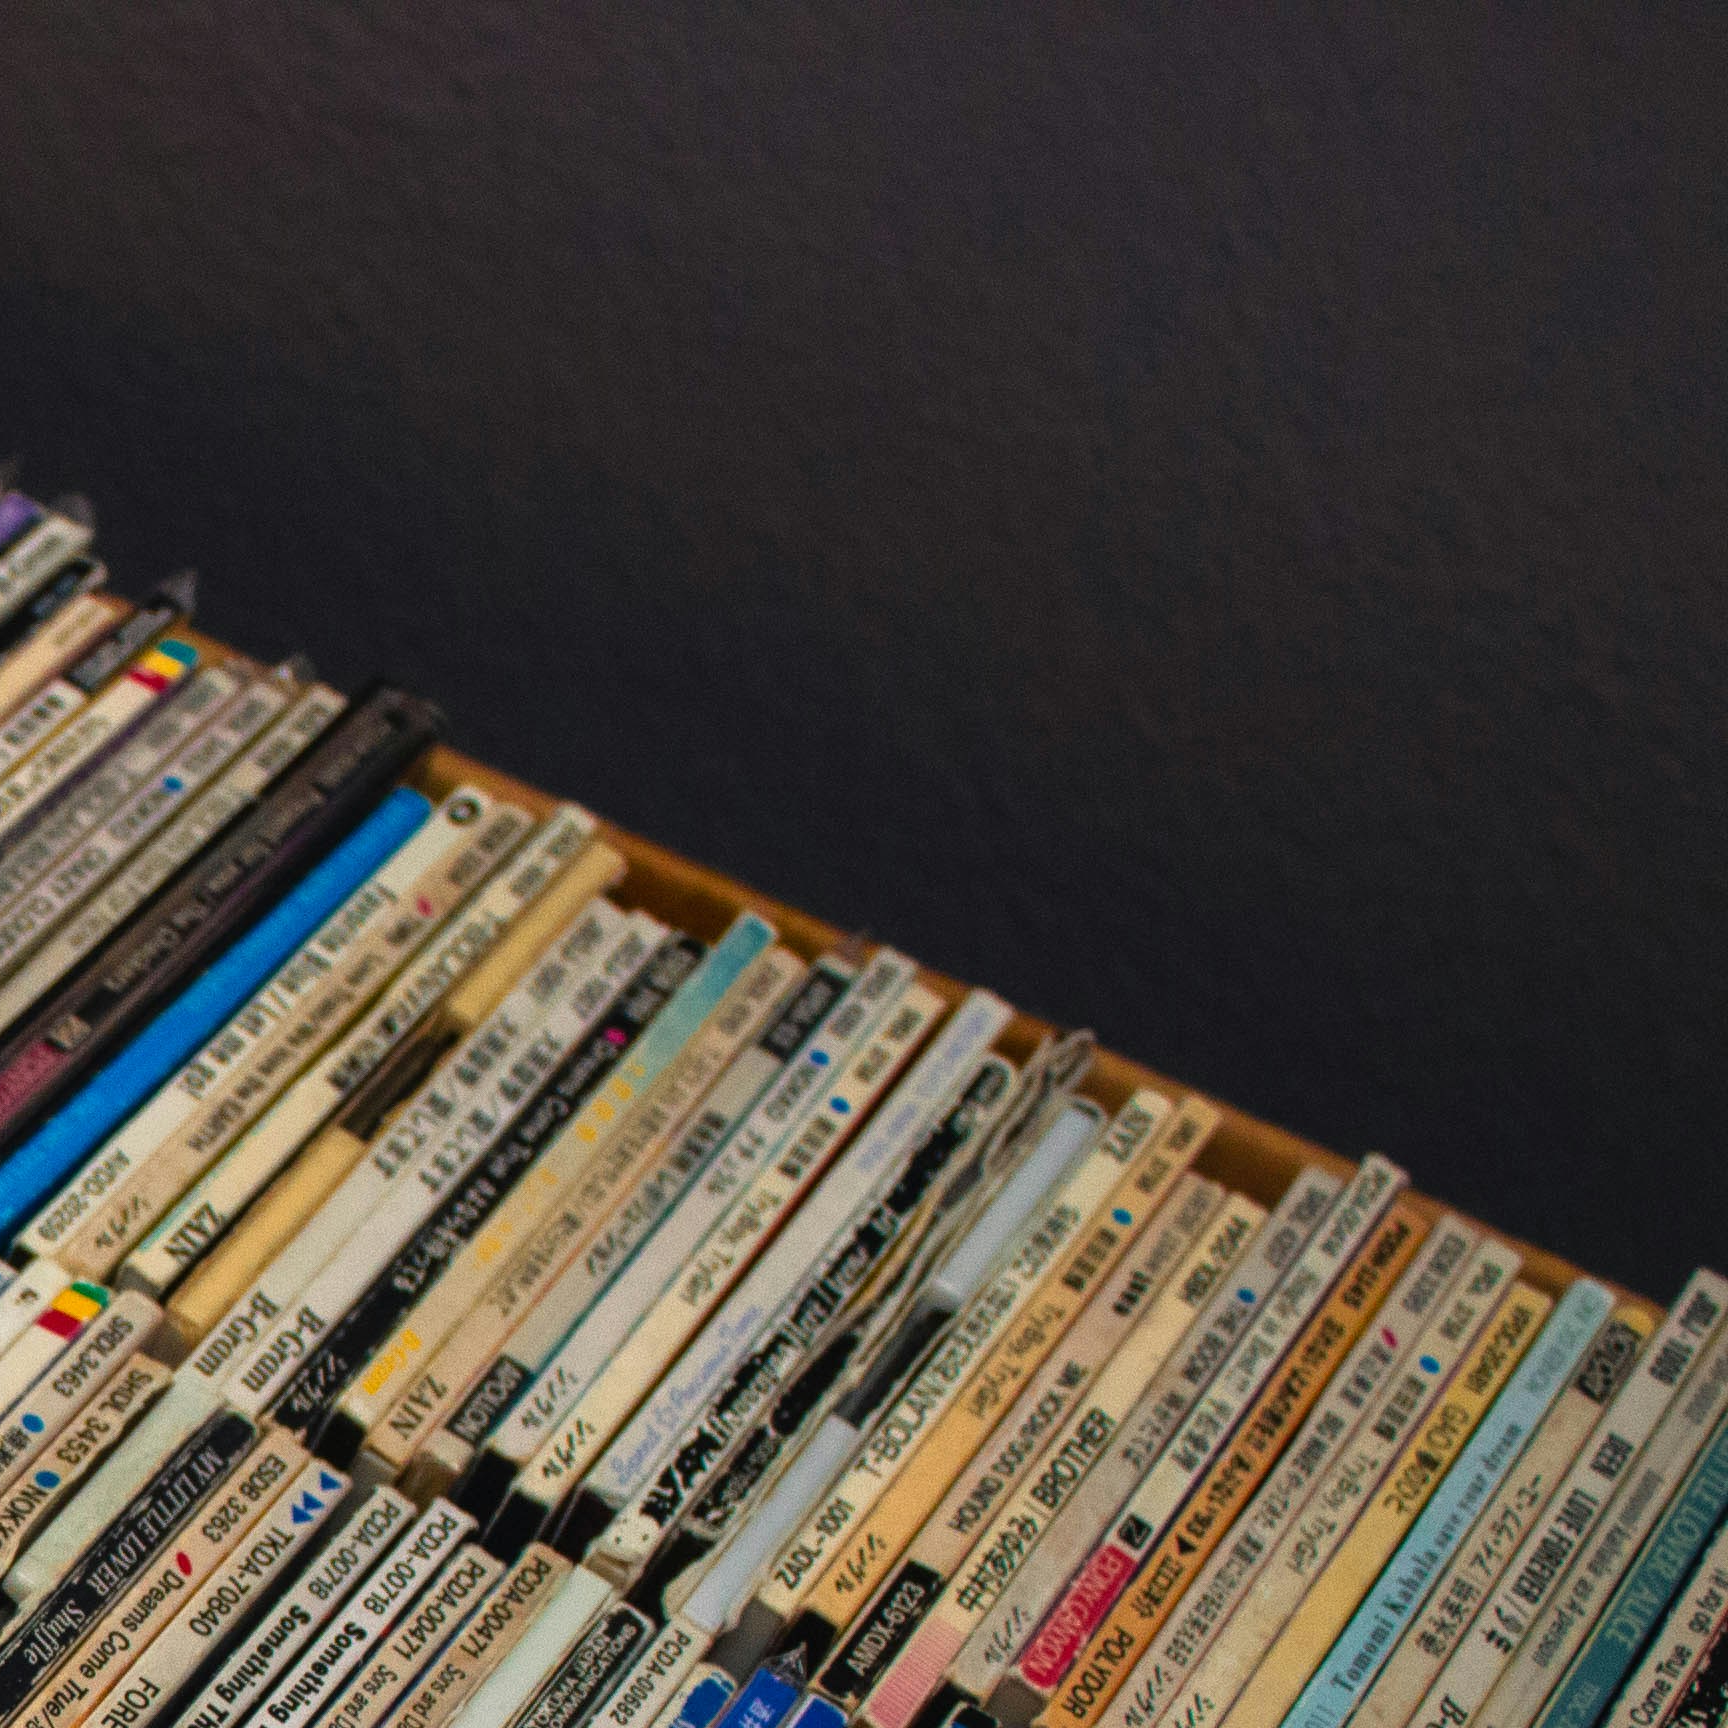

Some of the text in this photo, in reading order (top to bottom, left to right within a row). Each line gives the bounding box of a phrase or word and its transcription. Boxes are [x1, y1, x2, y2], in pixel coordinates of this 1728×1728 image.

[1024, 1408, 1123, 1510] BROTHER
[209, 1601, 319, 1706] Something
[839, 1580, 932, 1675] AMDX-6123
[1650, 1639, 1700, 1687] True
